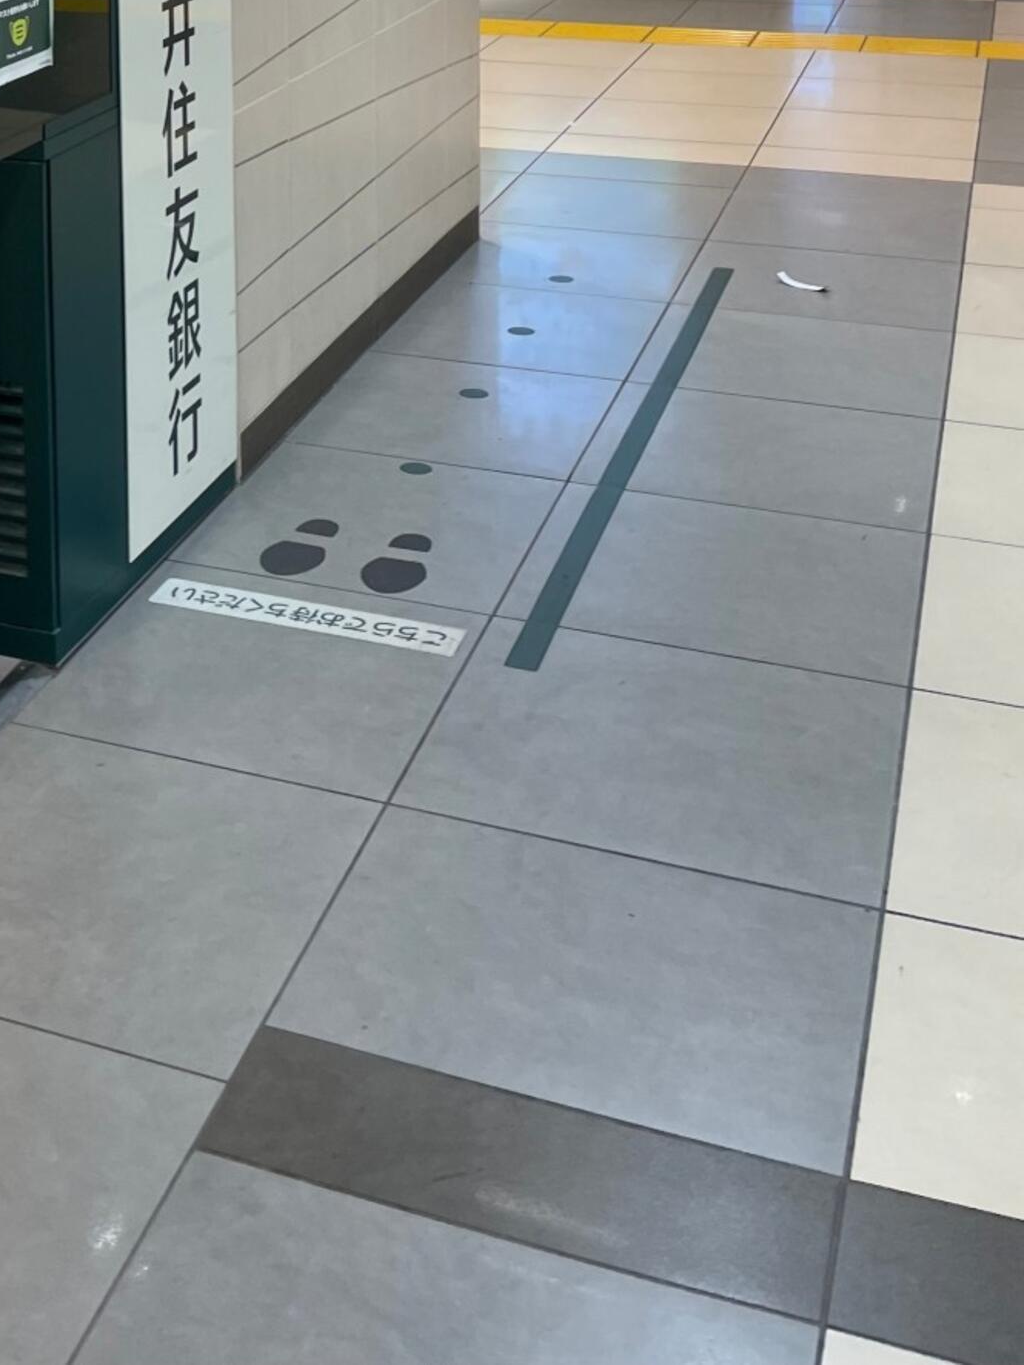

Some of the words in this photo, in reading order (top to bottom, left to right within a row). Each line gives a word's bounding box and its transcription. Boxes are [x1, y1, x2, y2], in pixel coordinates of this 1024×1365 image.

[171, 586, 448, 647] こちらでお待ちください
